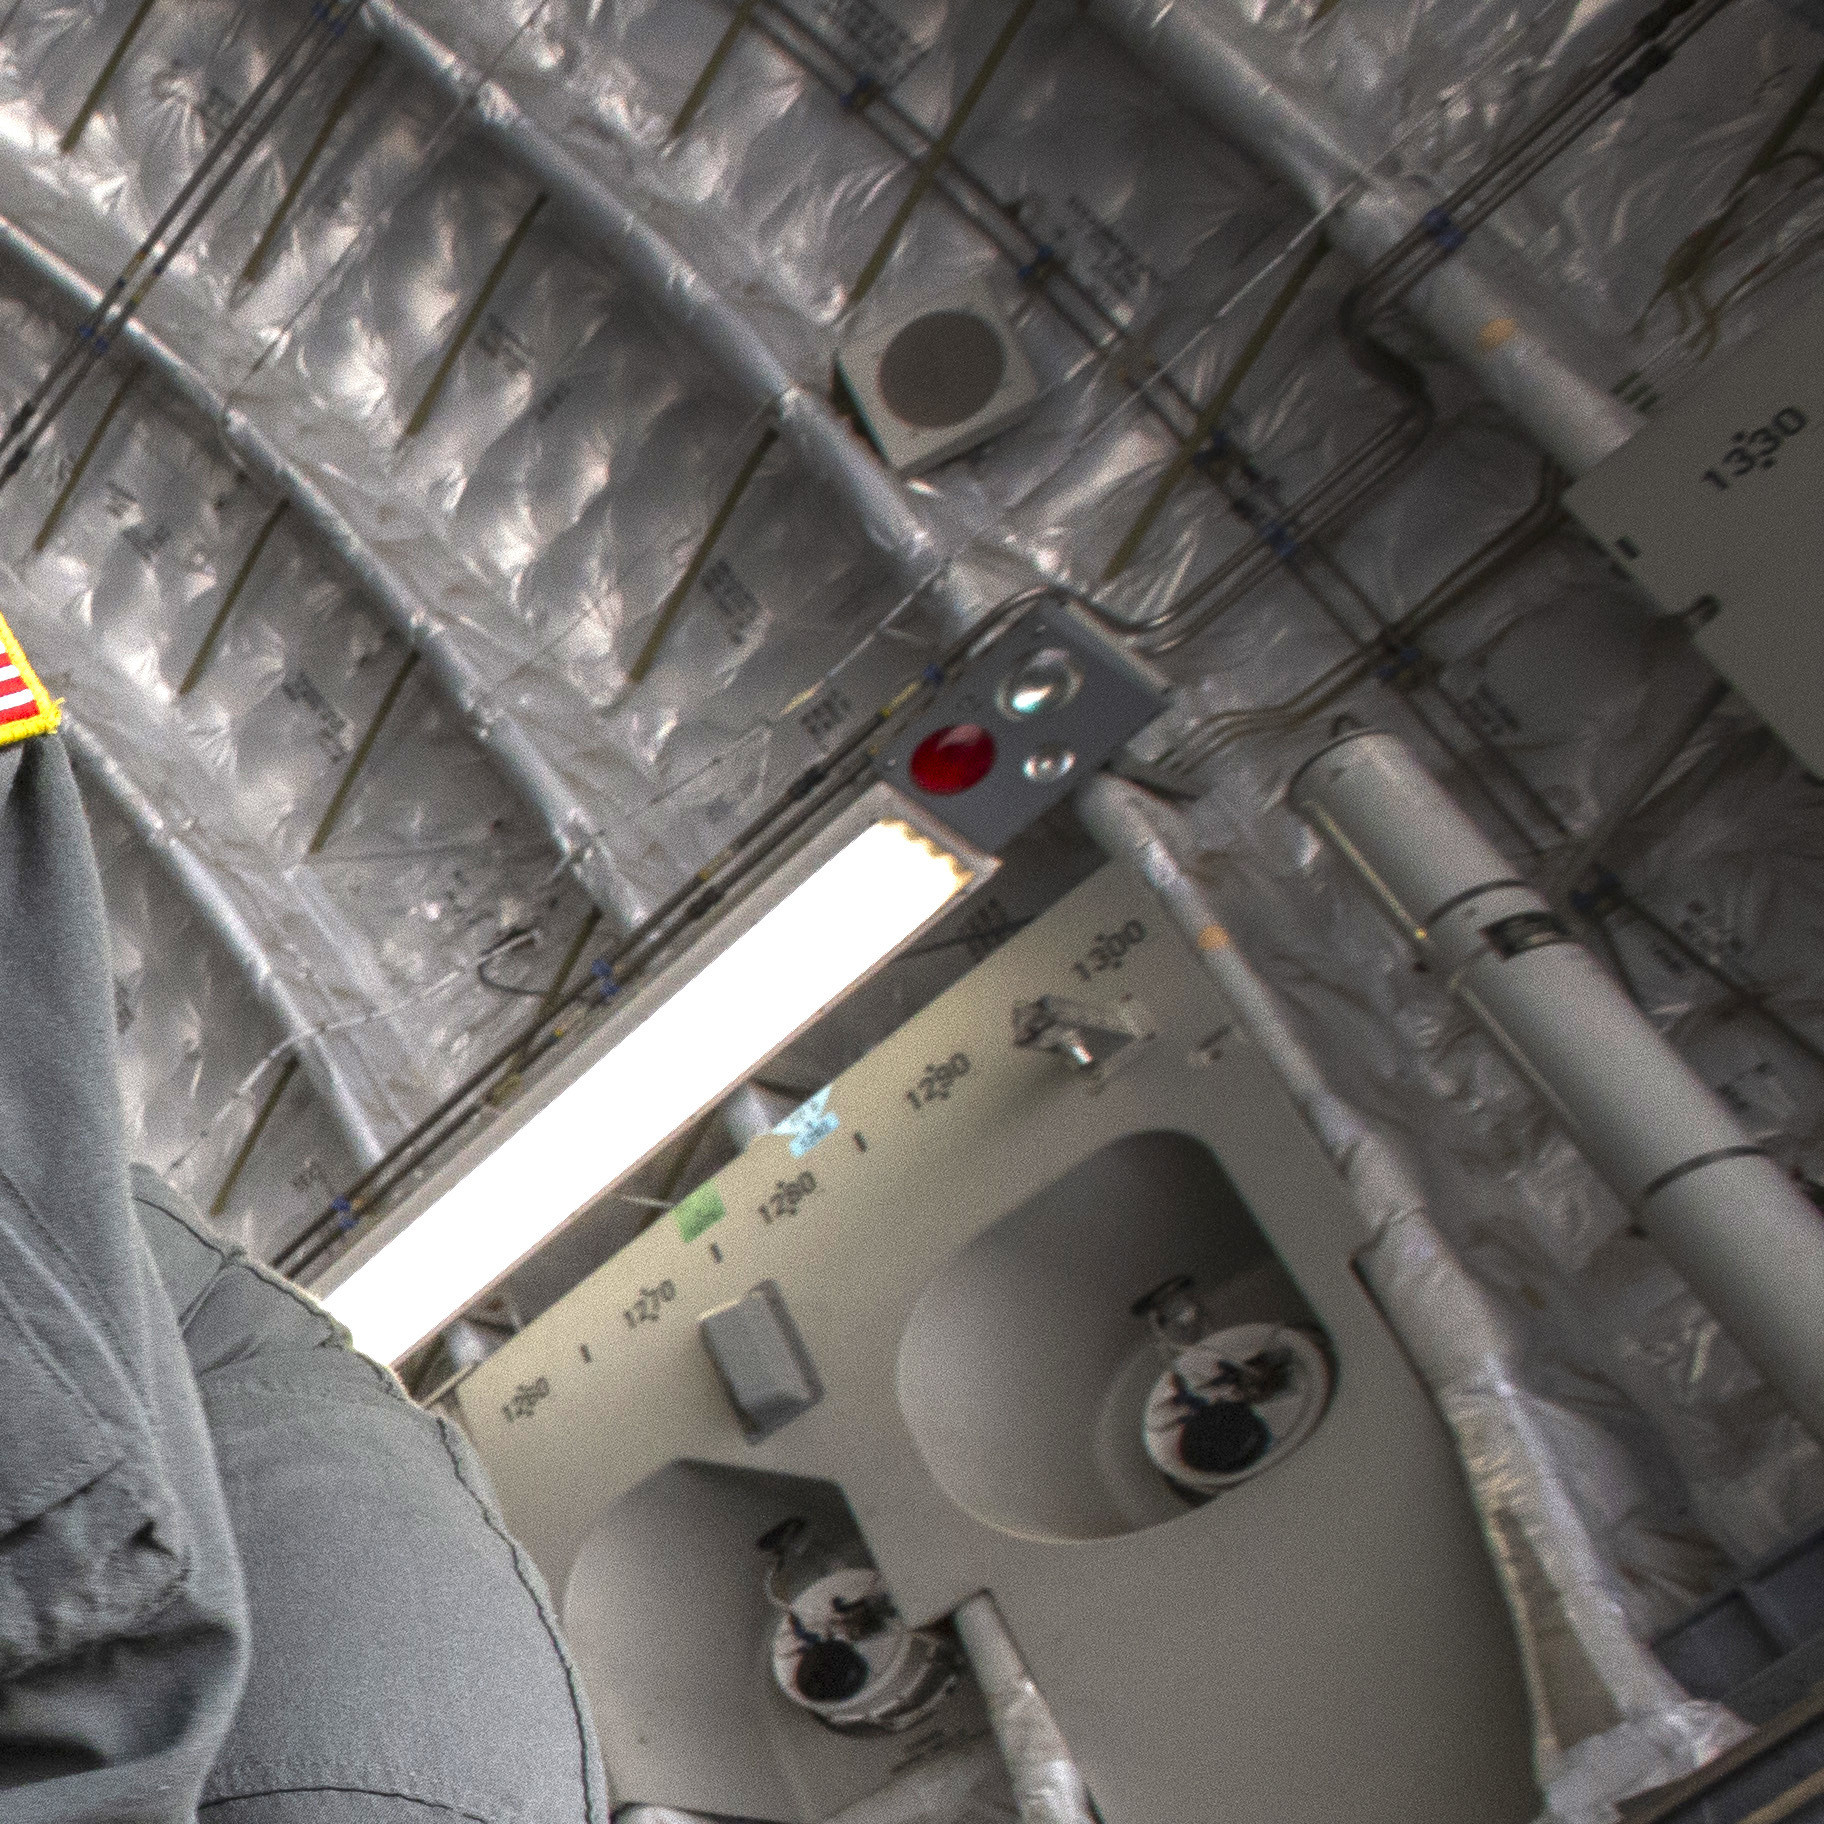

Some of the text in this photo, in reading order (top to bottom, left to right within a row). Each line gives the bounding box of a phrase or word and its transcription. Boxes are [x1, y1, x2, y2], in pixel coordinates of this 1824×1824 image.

[1699, 405, 1809, 491] 1330
[1074, 919, 1145, 981] 1300
[622, 1278, 677, 1329] 1270
